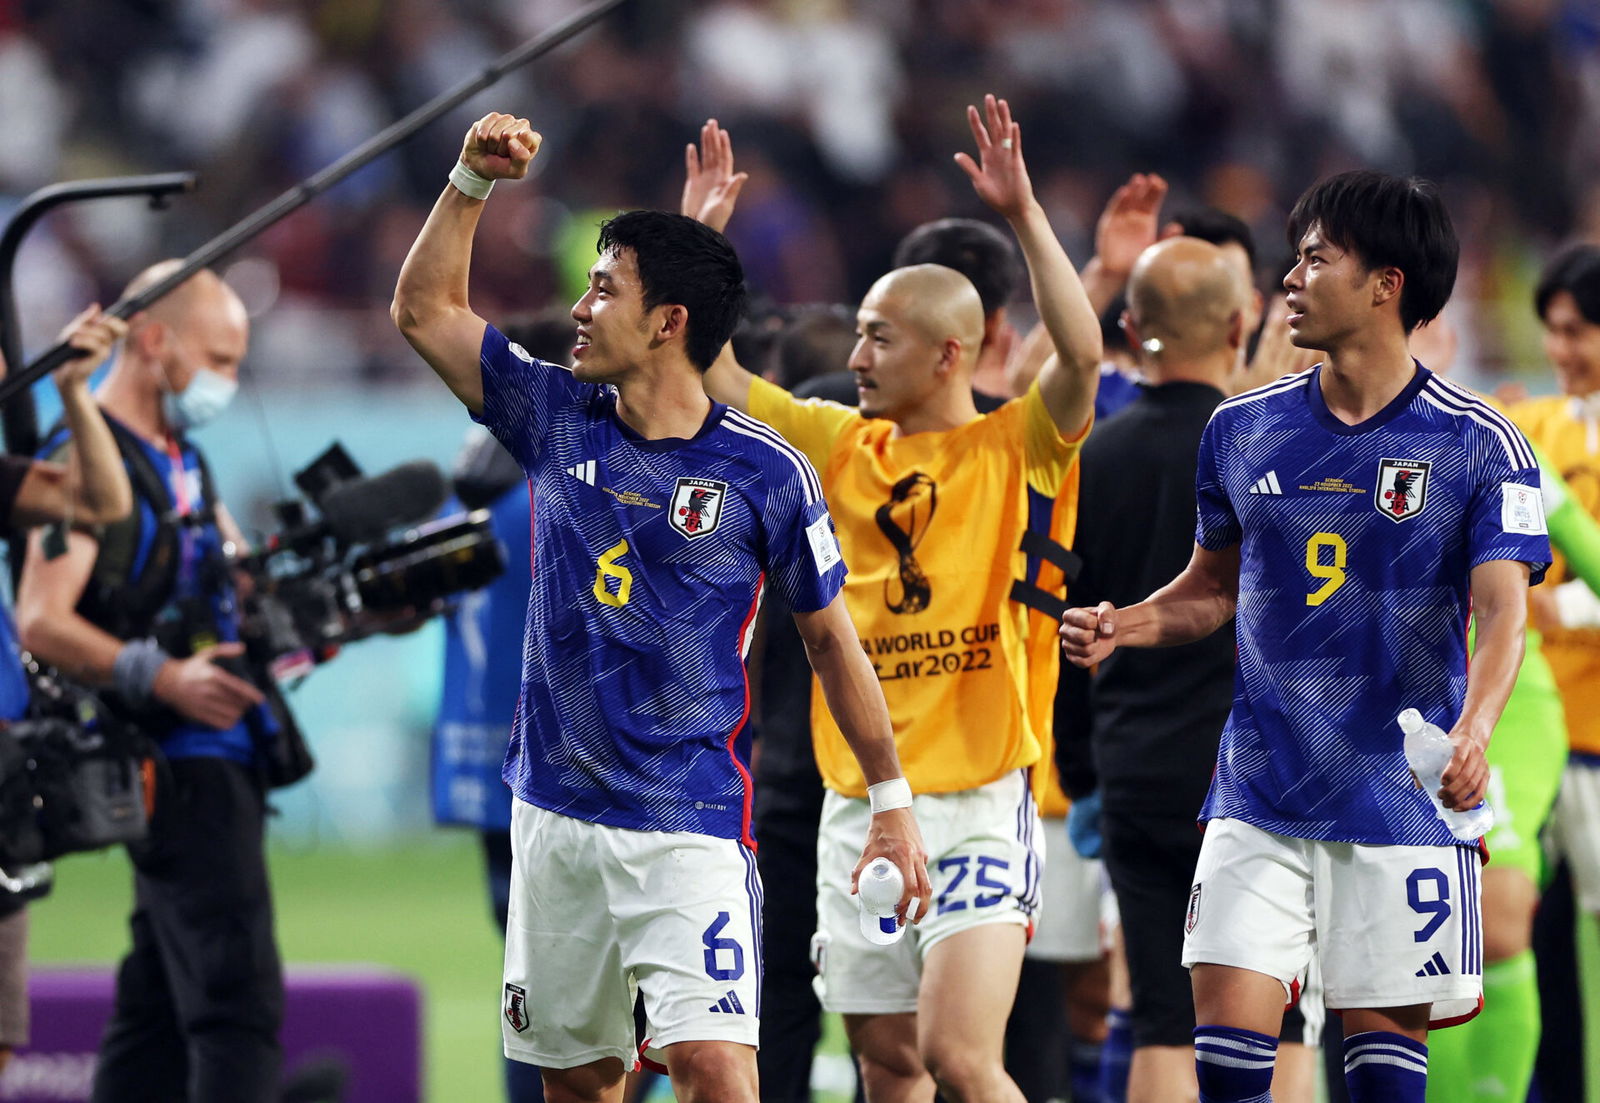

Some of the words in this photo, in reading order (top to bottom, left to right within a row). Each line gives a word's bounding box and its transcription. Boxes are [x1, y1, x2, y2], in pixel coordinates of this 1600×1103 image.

[688, 480, 715, 488] JAPAN
[1387, 501, 1410, 511] JFA
[681, 517, 703, 529] JFA
[593, 538, 632, 608] 6
[1306, 532, 1347, 606] 9
[875, 630, 954, 655] WORLD
[961, 623, 1000, 645] CUP
[872, 648, 992, 681] tar2022
[937, 856, 1011, 916] 25
[1406, 867, 1451, 943] 9
[702, 911, 745, 981] 6
